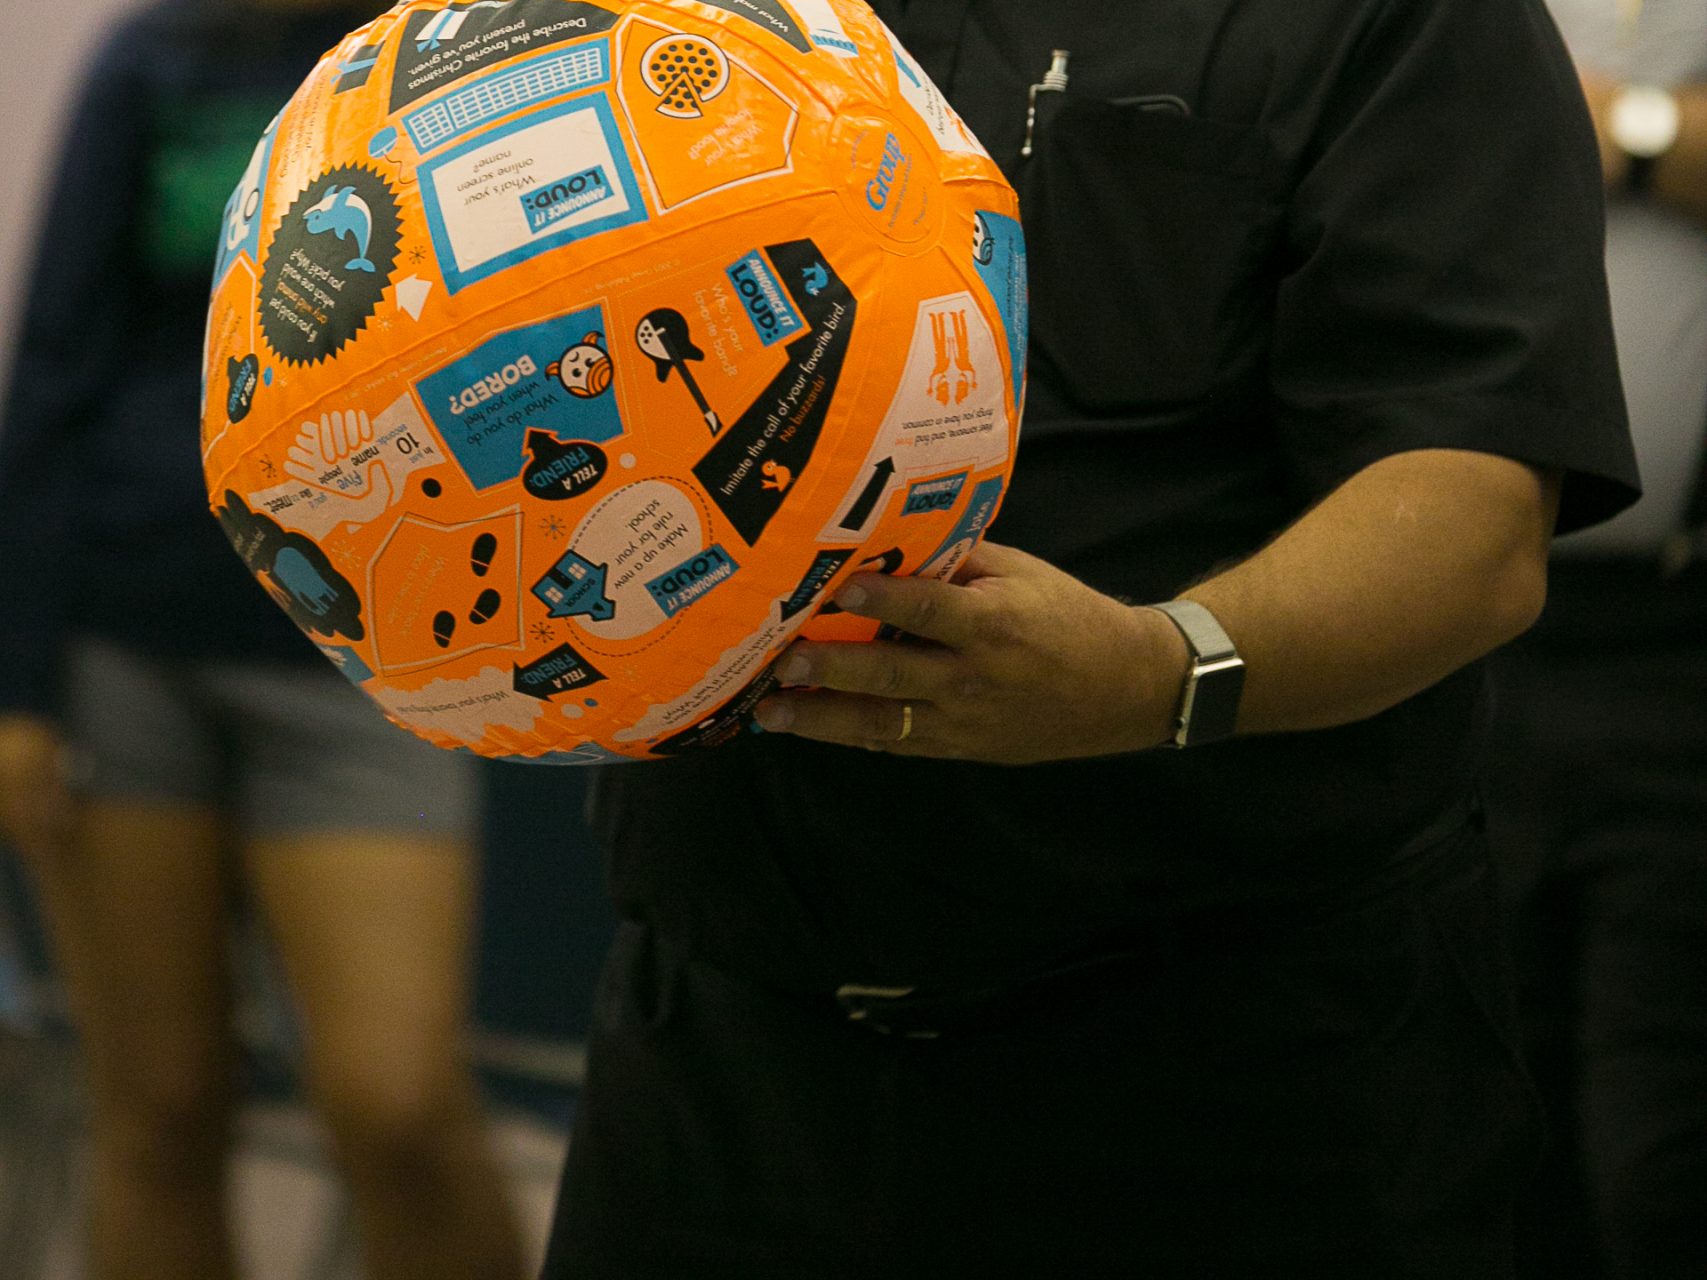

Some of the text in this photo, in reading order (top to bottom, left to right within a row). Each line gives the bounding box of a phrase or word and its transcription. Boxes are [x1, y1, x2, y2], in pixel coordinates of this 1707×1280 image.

[407, 19, 526, 74] present you've given.
[407, 17, 587, 90] Describe the favorite Christmas
[456, 157, 534, 193] online screen
[473, 149, 512, 174] name?
[866, 131, 906, 212] Group
[463, 174, 537, 206] What's your
[525, 169, 601, 211] LOUD:
[533, 186, 608, 228] ANNOUNCE IT
[711, 282, 744, 353] Who's your
[731, 262, 780, 340] LOUD:
[747, 258, 795, 328] ANNOUNCE IT
[297, 319, 314, 334] you
[693, 288, 739, 377] favorite band?
[448, 354, 538, 415] BORED?
[463, 381, 541, 430] when you feel
[719, 300, 847, 497] Imitate the call of your favorite bird.
[779, 374, 827, 444] No buzzards!
[395, 432, 421, 455] 10
[467, 392, 560, 447] What do you do
[317, 464, 344, 485] people
[350, 445, 381, 467] name
[561, 463, 599, 491] TELL A
[614, 511, 674, 566] rule for your
[624, 498, 661, 534] school.
[613, 523, 689, 591] Make up a new
[651, 549, 726, 597] LOUD:
[564, 577, 598, 609] SCHOOL
[667, 561, 732, 611] ANNOUNCE IT
[552, 667, 587, 689] TELL A
